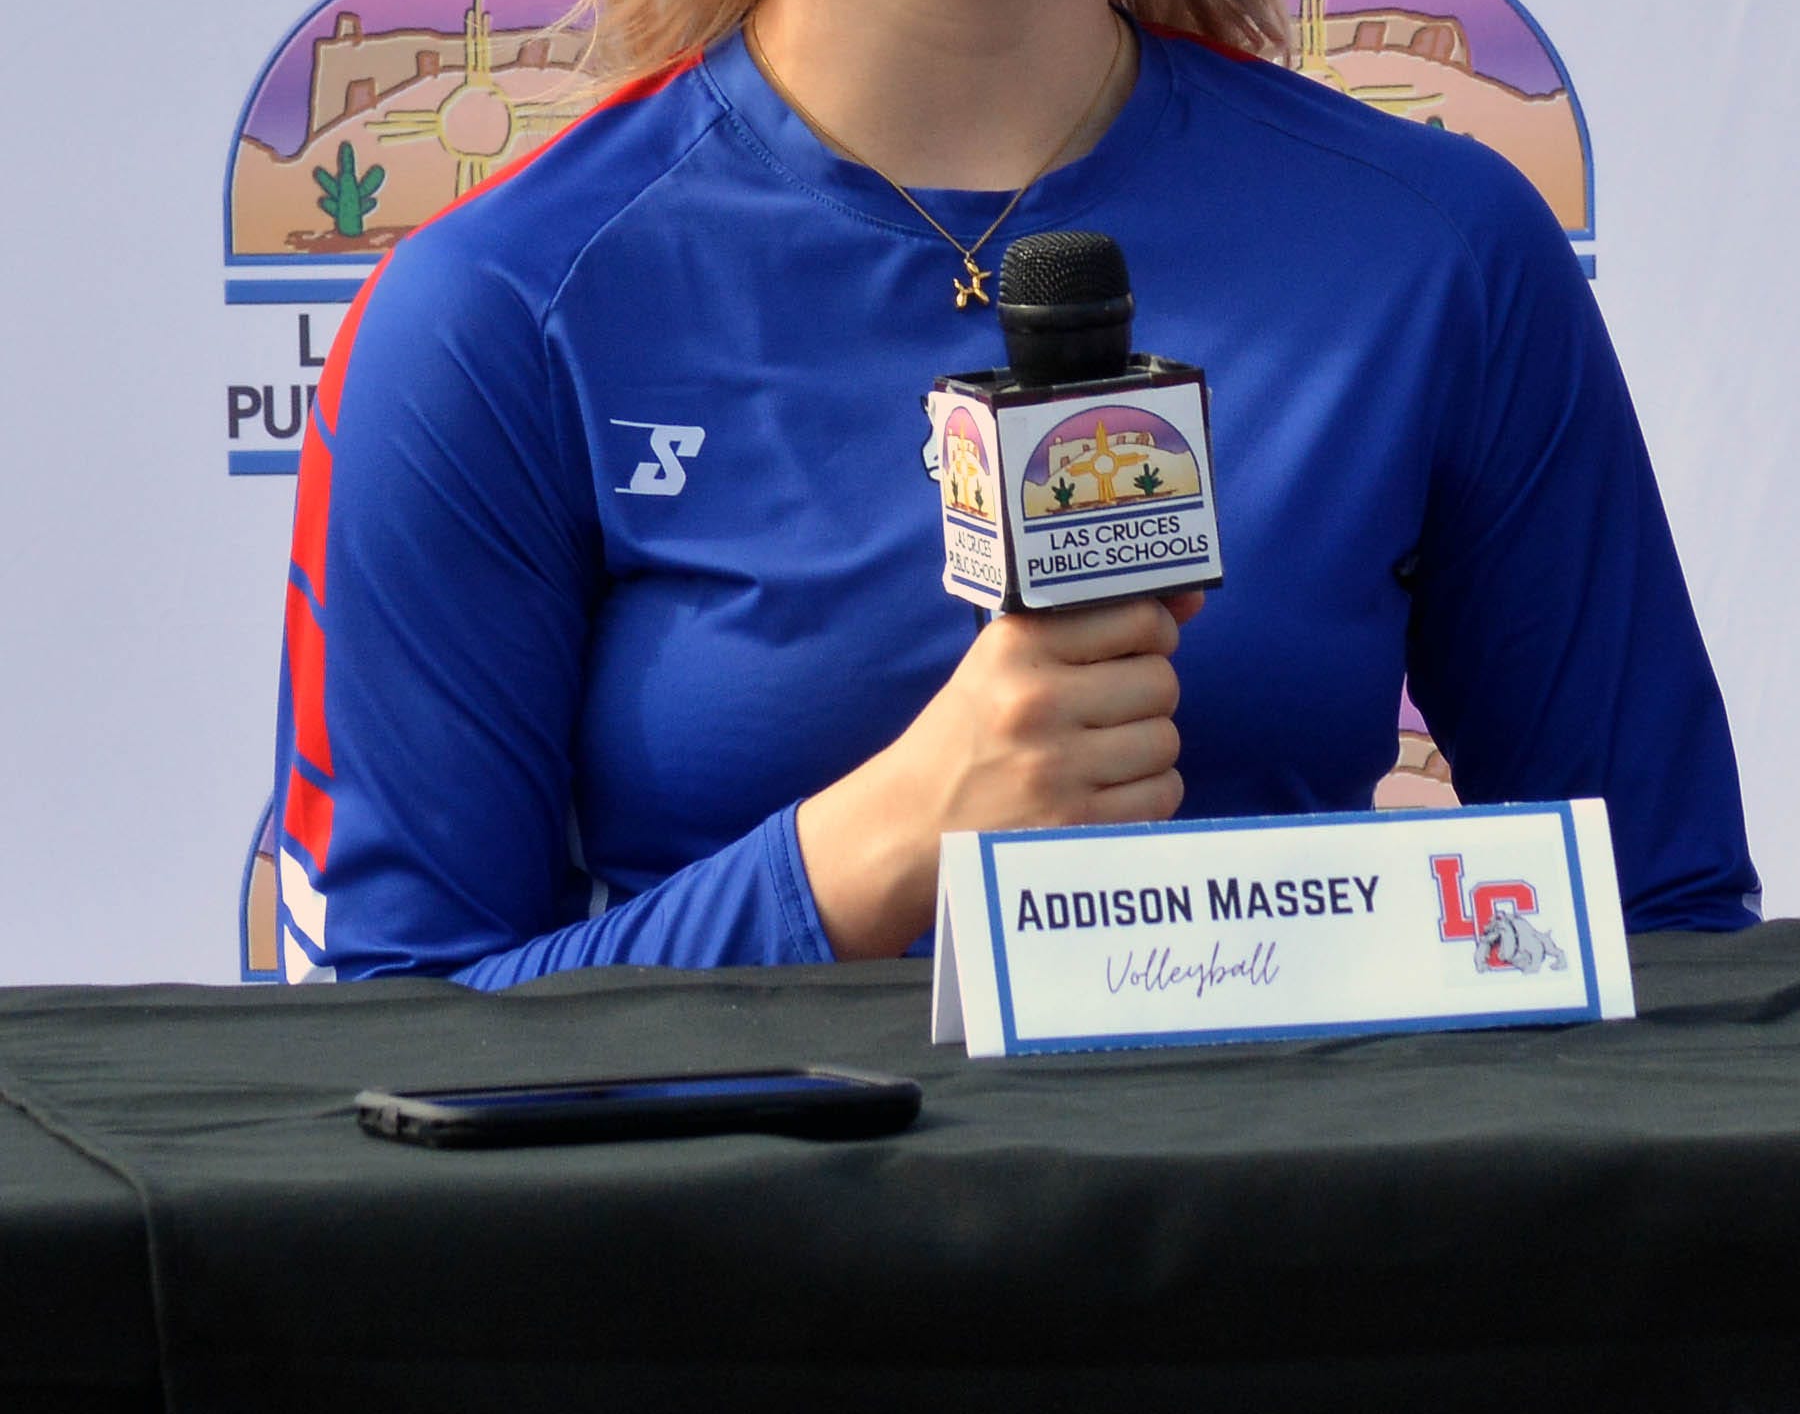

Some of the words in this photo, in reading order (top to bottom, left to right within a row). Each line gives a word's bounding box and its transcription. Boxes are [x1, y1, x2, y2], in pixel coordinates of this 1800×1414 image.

[1050, 528, 1090, 551] LAS
[1095, 515, 1180, 544] CRUCES
[1028, 550, 1100, 577] PUBLIC
[1105, 534, 1209, 566] SCHOOLS
[1106, 940, 1281, 998] Volleyball
